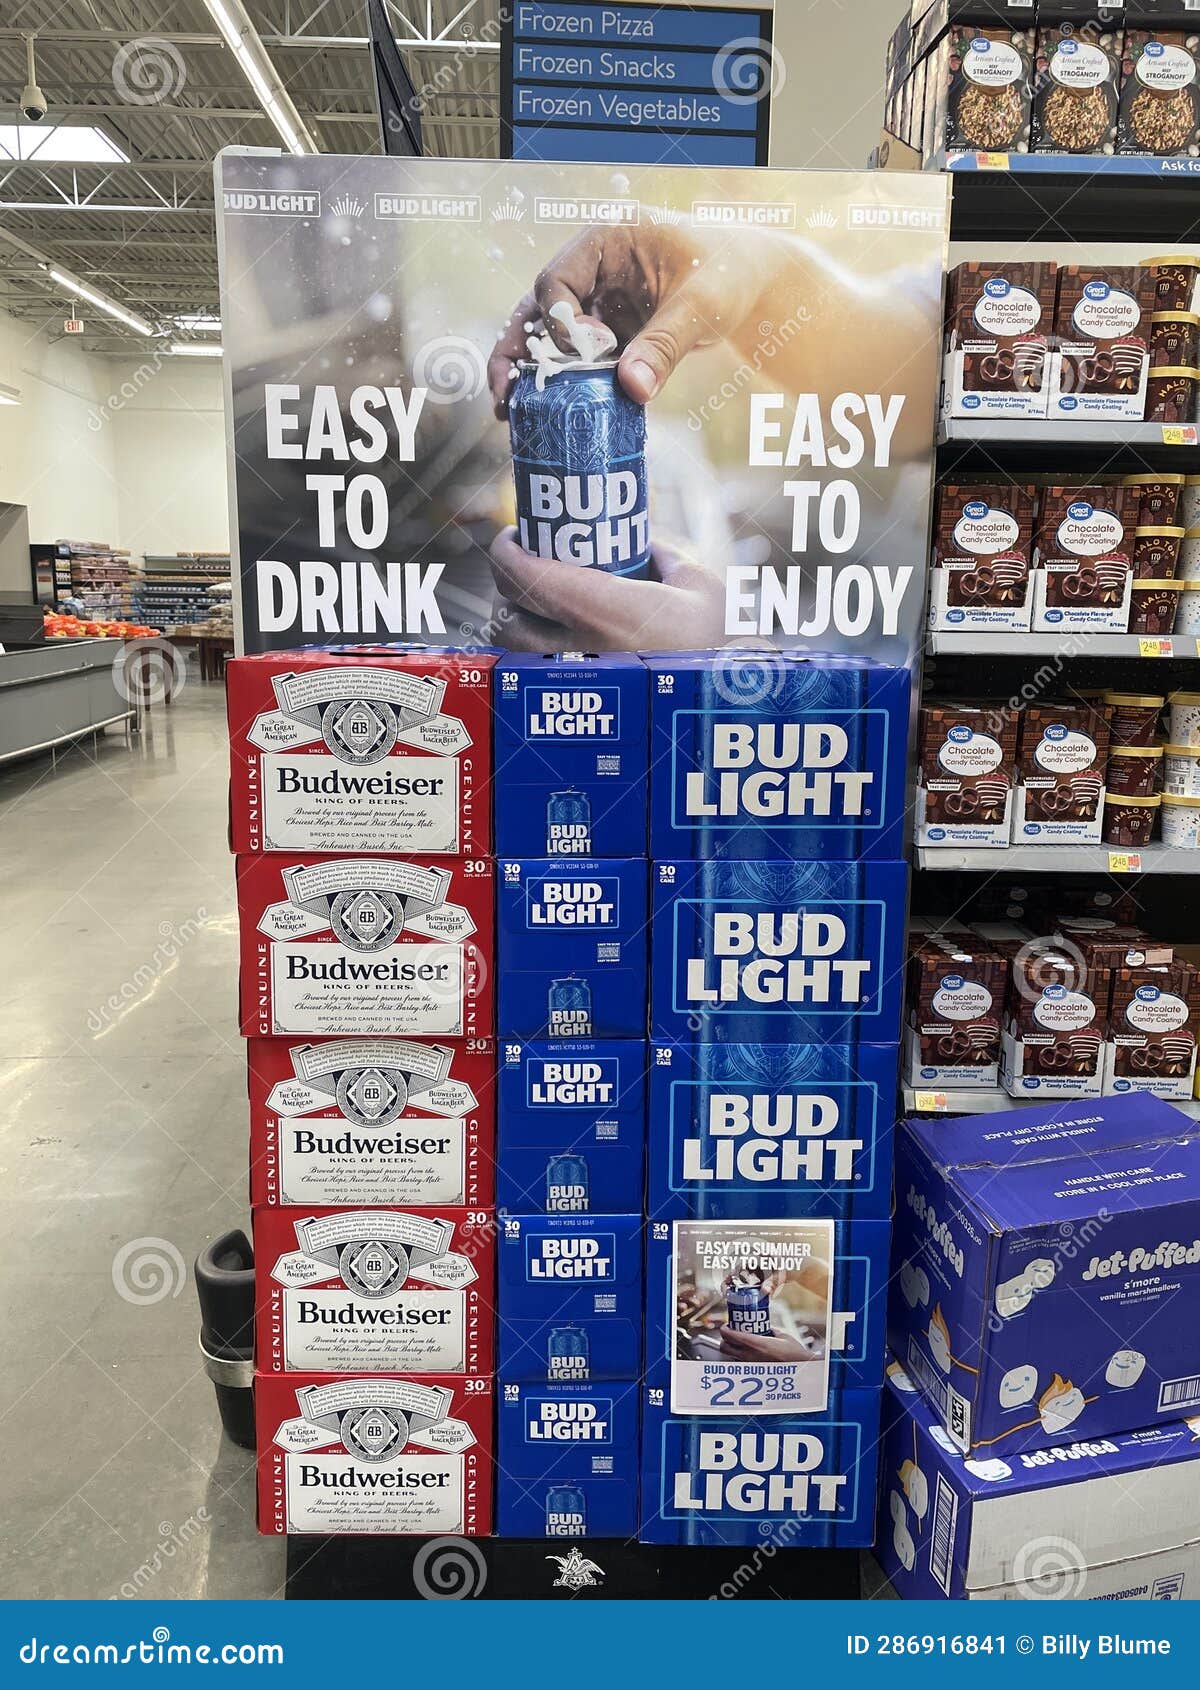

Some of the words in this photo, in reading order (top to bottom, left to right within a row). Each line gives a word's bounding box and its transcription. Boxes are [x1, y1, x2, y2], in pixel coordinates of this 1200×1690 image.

[519, 7, 593, 33] Frozen
[601, 11, 655, 37] Pizza
[519, 48, 592, 76] Frozen
[600, 53, 676, 79] Snacks
[1146, 72, 1186, 80] STROGANOFF
[519, 90, 592, 117] Frozen
[600, 94, 721, 123] Vegetables
[1162, 161, 1186, 170] Ask
[258, 195, 317, 212] LIGHT
[380, 198, 420, 215] BUD
[421, 200, 477, 217] LIGHT
[539, 203, 579, 218] BUD
[581, 204, 635, 220] LIGHT
[696, 206, 735, 223] BUD
[741, 208, 792, 224] LIGHT
[852, 209, 890, 224] BUD
[984, 303, 1033, 312] Chocolate
[1083, 305, 1132, 314] Chocolate
[981, 316, 1004, 325] Candy
[1006, 317, 1033, 325] Coating
[264, 383, 428, 464] EASY
[749, 393, 906, 468] EASY
[530, 471, 637, 520] BUD
[306, 474, 388, 550] TO
[784, 480, 860, 553] TO
[963, 523, 1010, 532] Chocolate
[1067, 525, 1115, 533] Chocolate
[520, 510, 647, 567] LIGHT
[961, 536, 983, 544] Candy
[985, 536, 1011, 544] Coating
[256, 560, 448, 634] DRINK
[725, 565, 913, 636] ENJOY
[1141, 592, 1167, 609] HALO
[459, 670, 481, 683] 30
[502, 673, 518, 683] 30
[658, 675, 674, 685] 30
[542, 692, 602, 713] BUD
[531, 714, 613, 735] LIGHT
[713, 723, 848, 769] BUD
[948, 747, 994, 755] Chocolate
[1044, 745, 1089, 753] Chocolate
[277, 768, 443, 796] Budweiser
[248, 754, 259, 850] GENUINE
[686, 771, 873, 817] LIGHT
[323, 808, 331, 816] by
[346, 809, 372, 818] original
[463, 759, 473, 854] GENUINE
[1113, 808, 1139, 822] HALO
[551, 825, 587, 839] BUD
[547, 838, 591, 853] LIGHT
[463, 861, 485, 873] 30
[504, 864, 521, 874] 30
[659, 866, 676, 876] 30
[543, 882, 602, 903] BUD
[532, 904, 613, 924] LIGHT
[714, 912, 846, 956] BUD
[286, 955, 448, 981] Budweiser
[259, 943, 268, 1034] GENUINE
[687, 958, 871, 1003] LIGHT
[467, 945, 476, 1036] GENUINE
[941, 993, 984, 1001] Chocolate
[552, 1010, 588, 1024] BUD
[1135, 1005, 1181, 1013] Chocolate
[548, 1024, 591, 1037] LIGHT
[466, 1038, 487, 1050] 30
[505, 1045, 521, 1055] 30
[656, 1048, 672, 1059] 30
[543, 1063, 602, 1083] BUD
[532, 1083, 613, 1103] LIGHT
[709, 1094, 838, 1136] BUD
[293, 1131, 450, 1154] Budweiser
[266, 1119, 276, 1204] GENUINE
[469, 1119, 478, 1205] GENUINE
[683, 1139, 862, 1181] LIGHT
[1054, 1188, 1087, 1198] STORE
[1088, 1185, 1098, 1193] IN
[1099, 1184, 1108, 1192] A
[1108, 1181, 1135, 1190] COOL
[1135, 1177, 1153, 1186] DRY
[1154, 1172, 1186, 1183] PLACE
[1064, 1173, 1103, 1186] HANDLE
[1103, 1171, 1127, 1180] WITH
[1127, 1167, 1153, 1177] CARE
[466, 1212, 487, 1224] 30
[504, 1221, 520, 1230] 30
[653, 1223, 668, 1232] 30
[542, 1239, 599, 1258] BUD
[696, 1241, 733, 1255] EASY
[733, 1242, 751, 1255] TO
[753, 1243, 811, 1257] SUMMER
[531, 1258, 610, 1278] LIGHT
[703, 1256, 738, 1269] EASY
[740, 1257, 758, 1270] TO
[760, 1257, 803, 1271] ENJOY
[1082, 1240, 1200, 1280] Jet-Puffed
[1100, 1292, 1126, 1301] vanilla
[1127, 1283, 1181, 1297] marshmallows
[1124, 1277, 1160, 1290] s'more
[298, 1301, 451, 1325] Budweiser
[733, 1310, 766, 1322] BUD
[271, 1289, 281, 1371] GENUINE
[469, 1290, 478, 1373] GENUINE
[704, 1365, 726, 1375] BUD
[728, 1366, 741, 1375] OR
[744, 1366, 765, 1375] BUD
[767, 1366, 797, 1375] LIGHT
[465, 1380, 485, 1391] 30
[504, 1385, 519, 1395] 30
[649, 1389, 663, 1399] 30
[541, 1402, 596, 1421] BUD
[530, 1421, 607, 1440] LIGHT
[699, 1432, 824, 1472] BUD
[1020, 1440, 1120, 1468] Jet-Puffed
[300, 1466, 449, 1488] Budweiser
[274, 1454, 283, 1533] GENUINE
[468, 1455, 476, 1534] GENUINE
[674, 1472, 846, 1512] LIGHT
